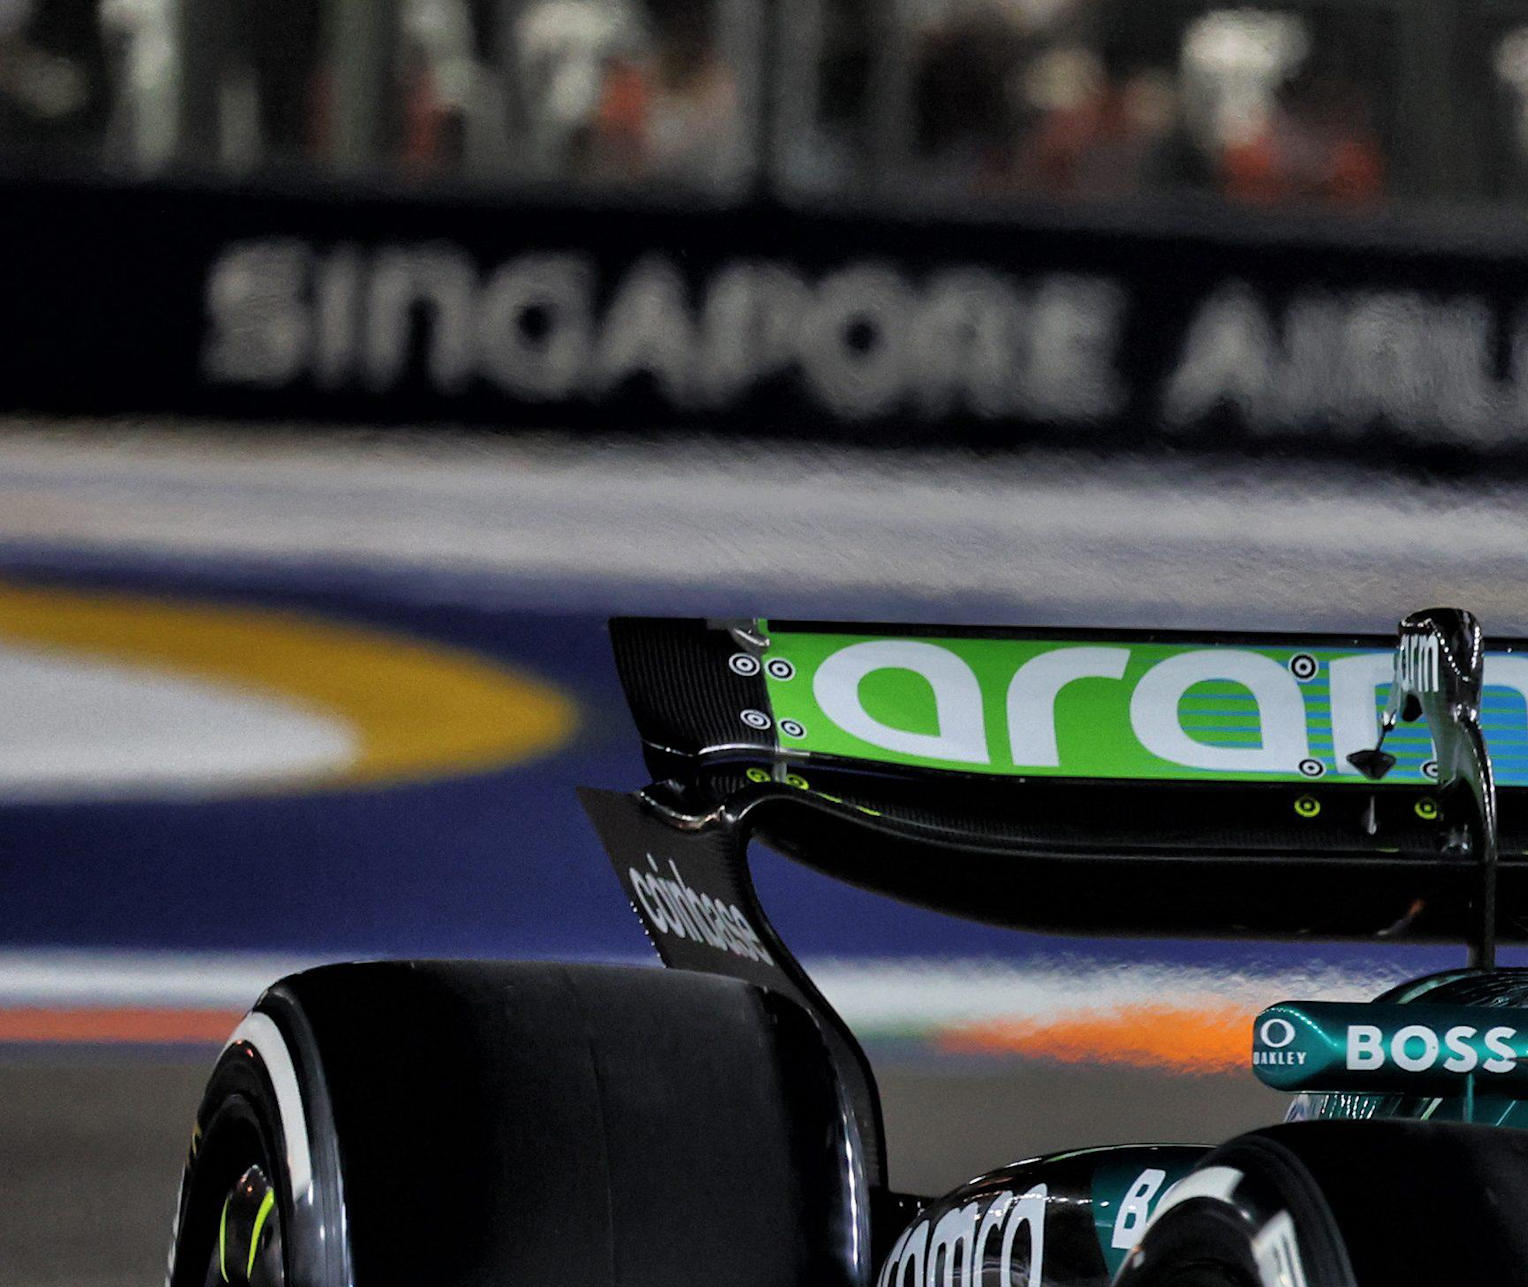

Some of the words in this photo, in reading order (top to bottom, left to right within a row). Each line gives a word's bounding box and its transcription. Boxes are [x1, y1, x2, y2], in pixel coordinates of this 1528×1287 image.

[203, 238, 1128, 422] SINGAPORE
[629, 853, 774, 966] coinbase
[1252, 1051, 1307, 1066] OAKLEY
[1346, 1024, 1518, 1074] BOSS
